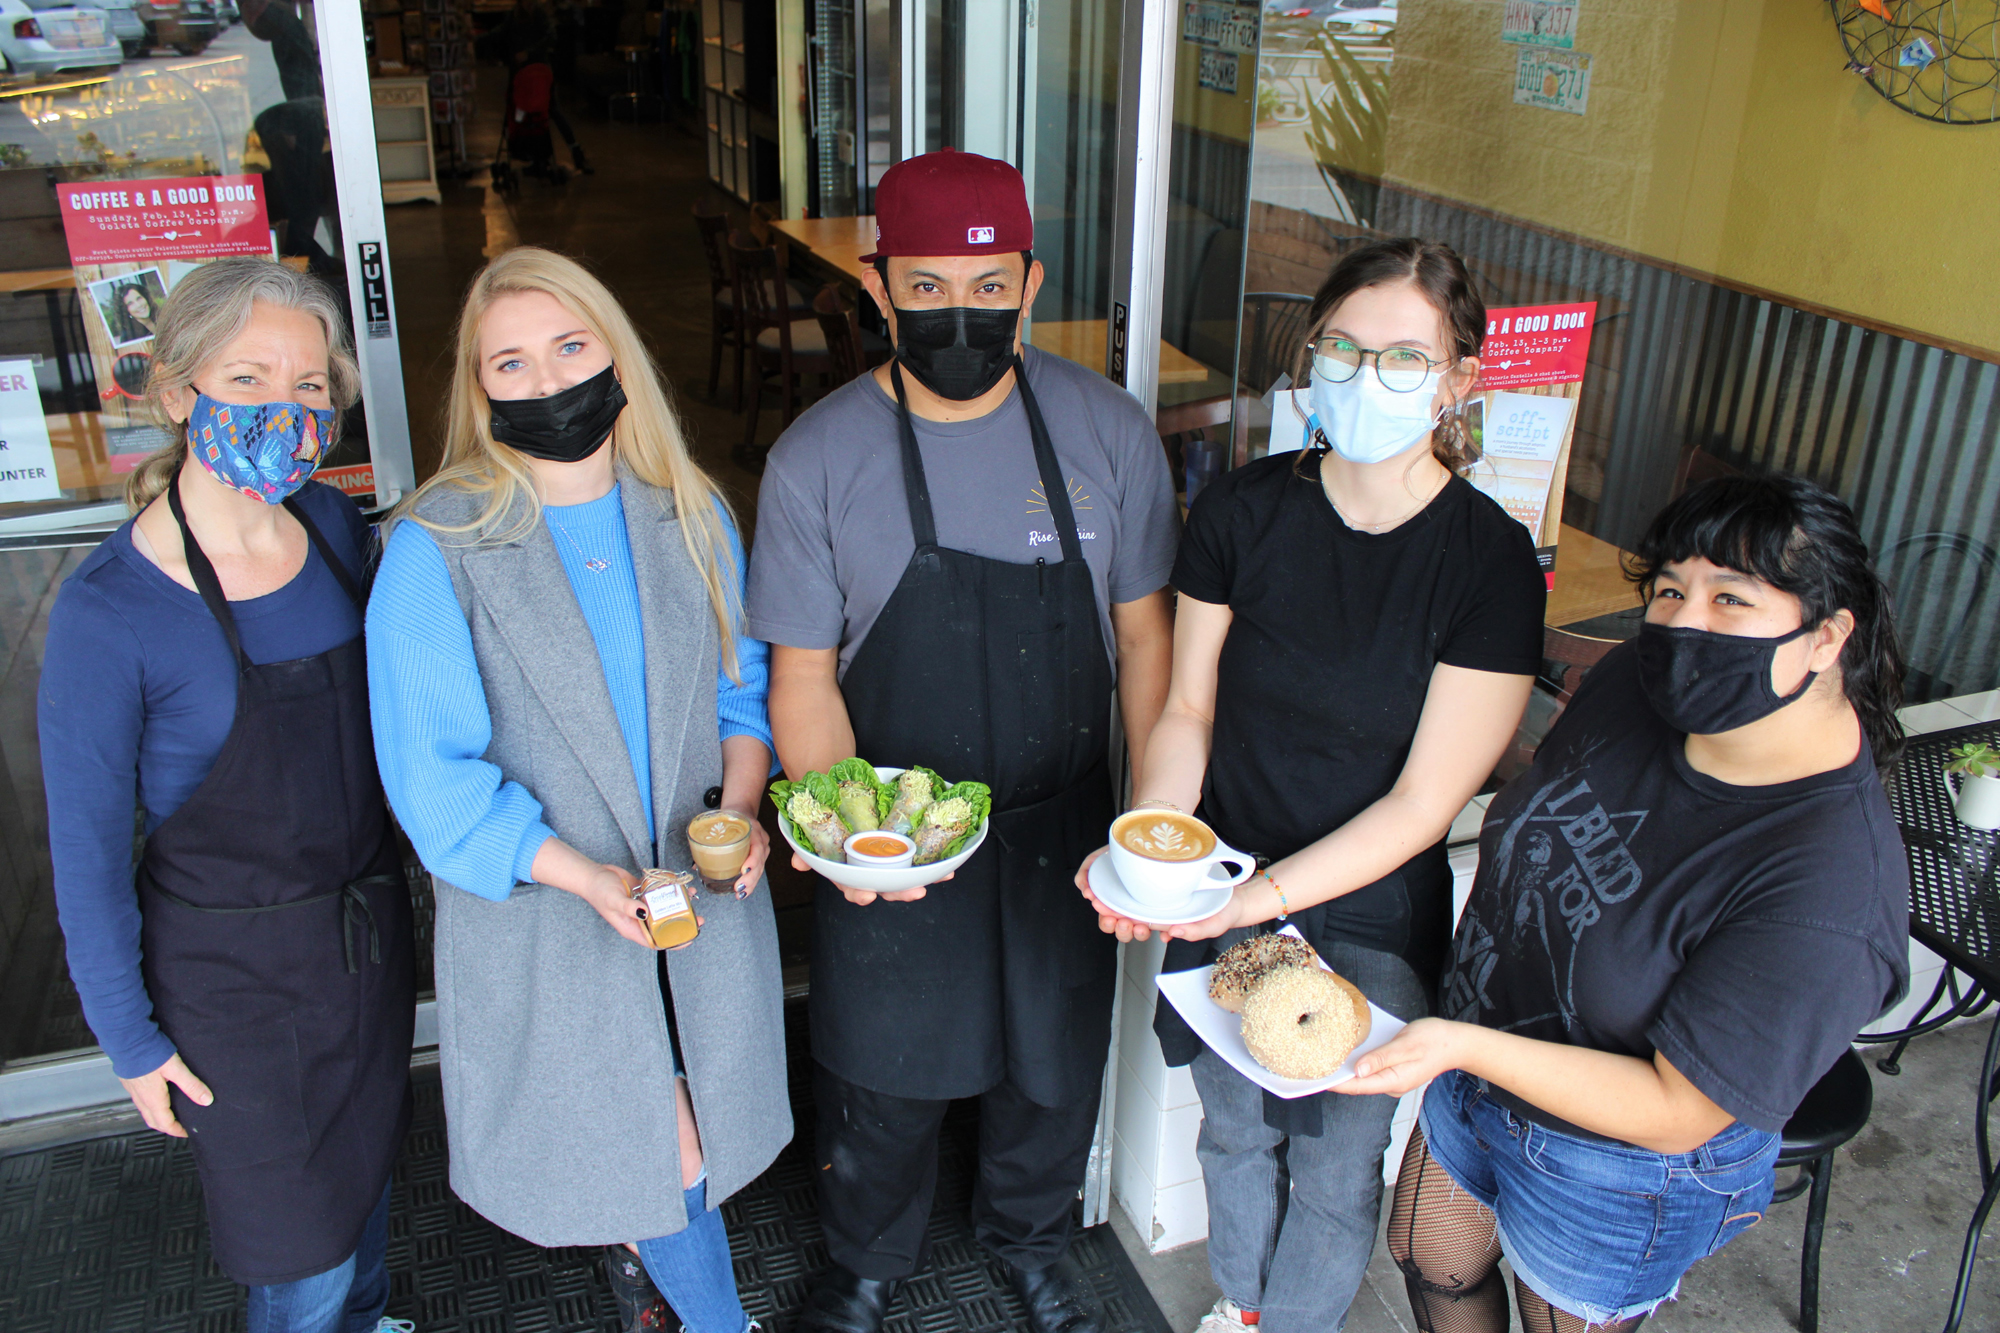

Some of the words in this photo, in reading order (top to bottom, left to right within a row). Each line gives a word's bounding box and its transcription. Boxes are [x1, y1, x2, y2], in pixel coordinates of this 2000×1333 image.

[1545, 6, 1572, 36] 337
[1558, 69, 1586, 100] 27J
[70, 191, 130, 210] COFFEE
[134, 192, 146, 207] &
[152, 189, 163, 206] A
[167, 187, 210, 205] GOOD
[214, 184, 256, 203] BOOK
[88, 214, 138, 224] Sunday,
[142, 212, 168, 220] Feb.
[220, 209, 244, 218] p.m.
[99, 222, 140, 230] Goleta
[145, 219, 184, 228] Coffee
[188, 217, 237, 226] Company
[363, 244, 384, 317] PULL
[1487, 320, 1497, 336] &
[1500, 318, 1510, 334] A
[1514, 315, 1550, 334] GOOD
[1553, 312, 1587, 331] BOOK
[1488, 341, 1509, 349] Feb.
[1552, 337, 1572, 345] p.m.
[1488, 348, 1520, 357] Coffee
[1524, 345, 1564, 354] Company
[1509, 410, 1546, 424] off-
[1496, 424, 1550, 442] script
[1029, 530, 1054, 546] Rise
[1559, 802, 1642, 904] BLED
[1546, 862, 1601, 944] FOR
